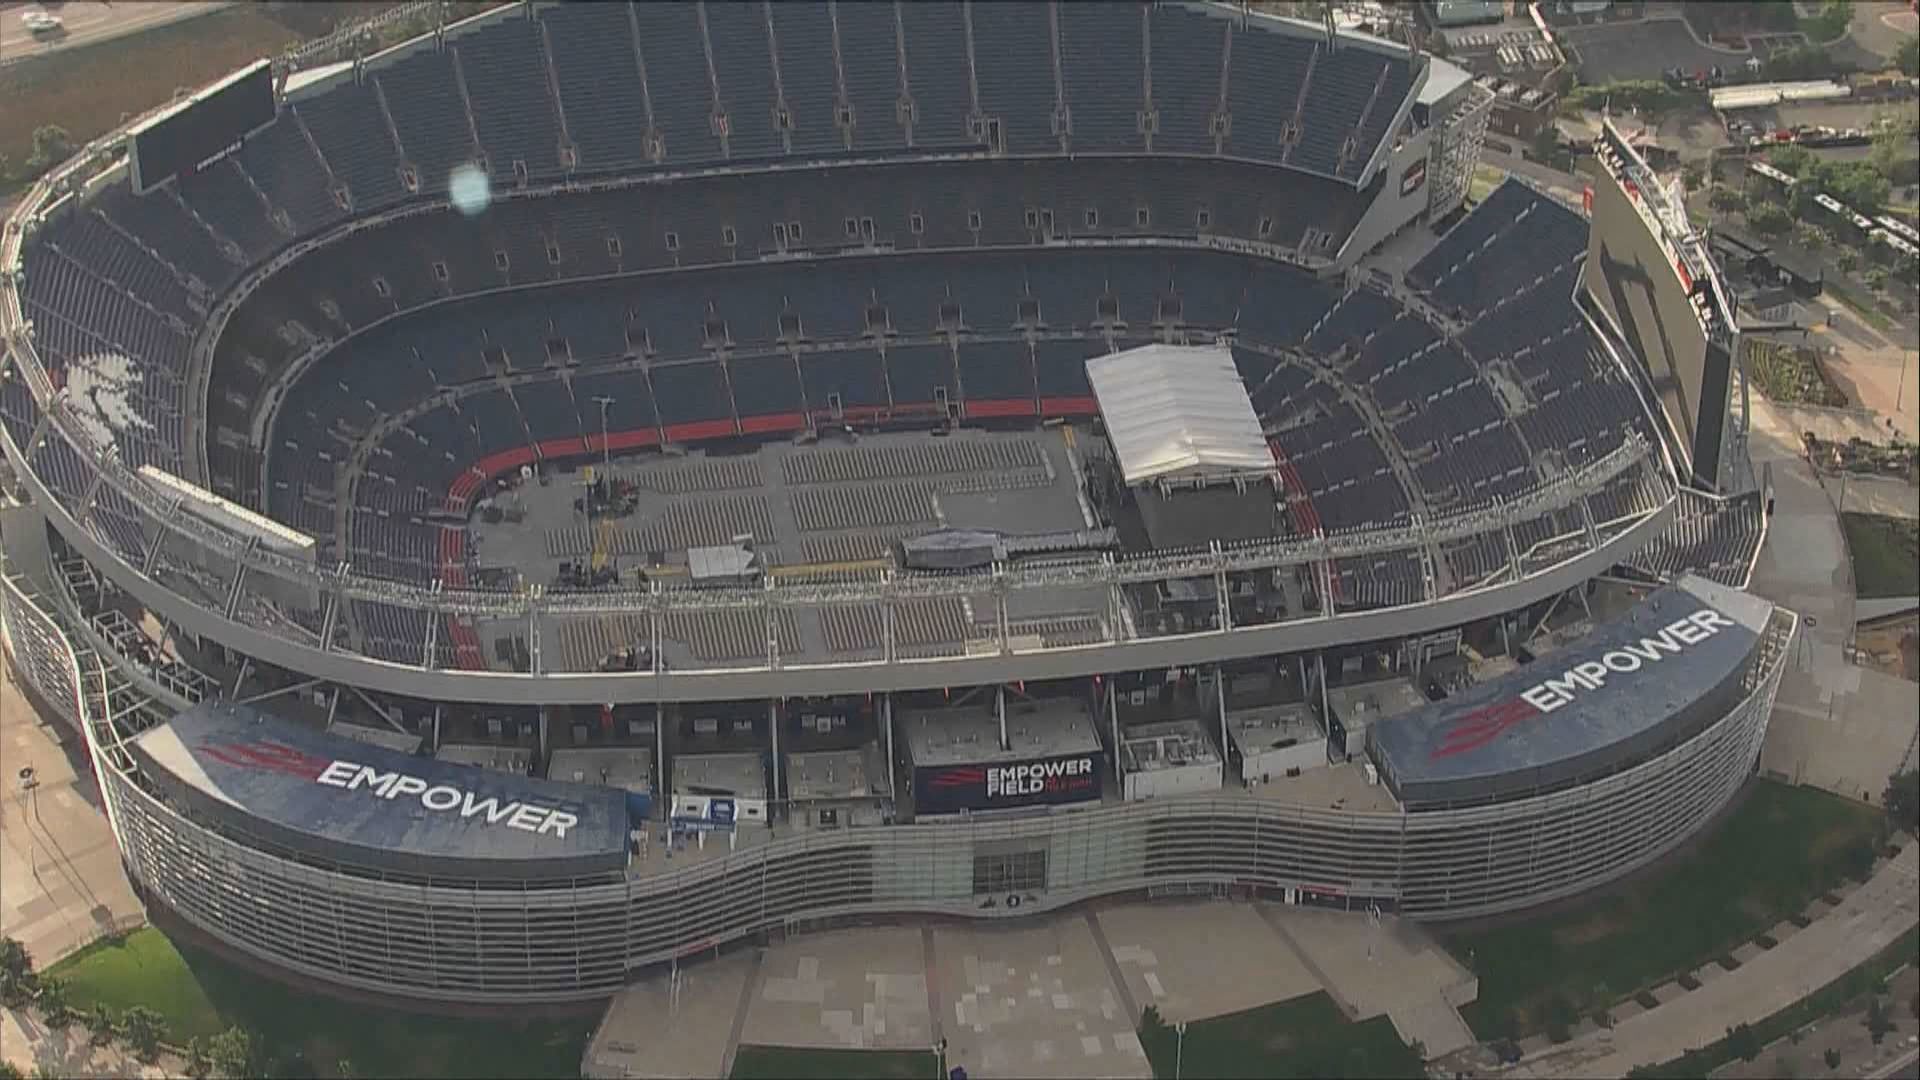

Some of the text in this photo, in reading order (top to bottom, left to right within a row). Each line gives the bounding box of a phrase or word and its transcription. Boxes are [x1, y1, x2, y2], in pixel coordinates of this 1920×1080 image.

[1521, 609, 1735, 712] EMPOWER
[987, 758, 1092, 782] EMPOWER
[987, 779, 1044, 797] FIELD
[317, 760, 578, 838] EMPOWER
